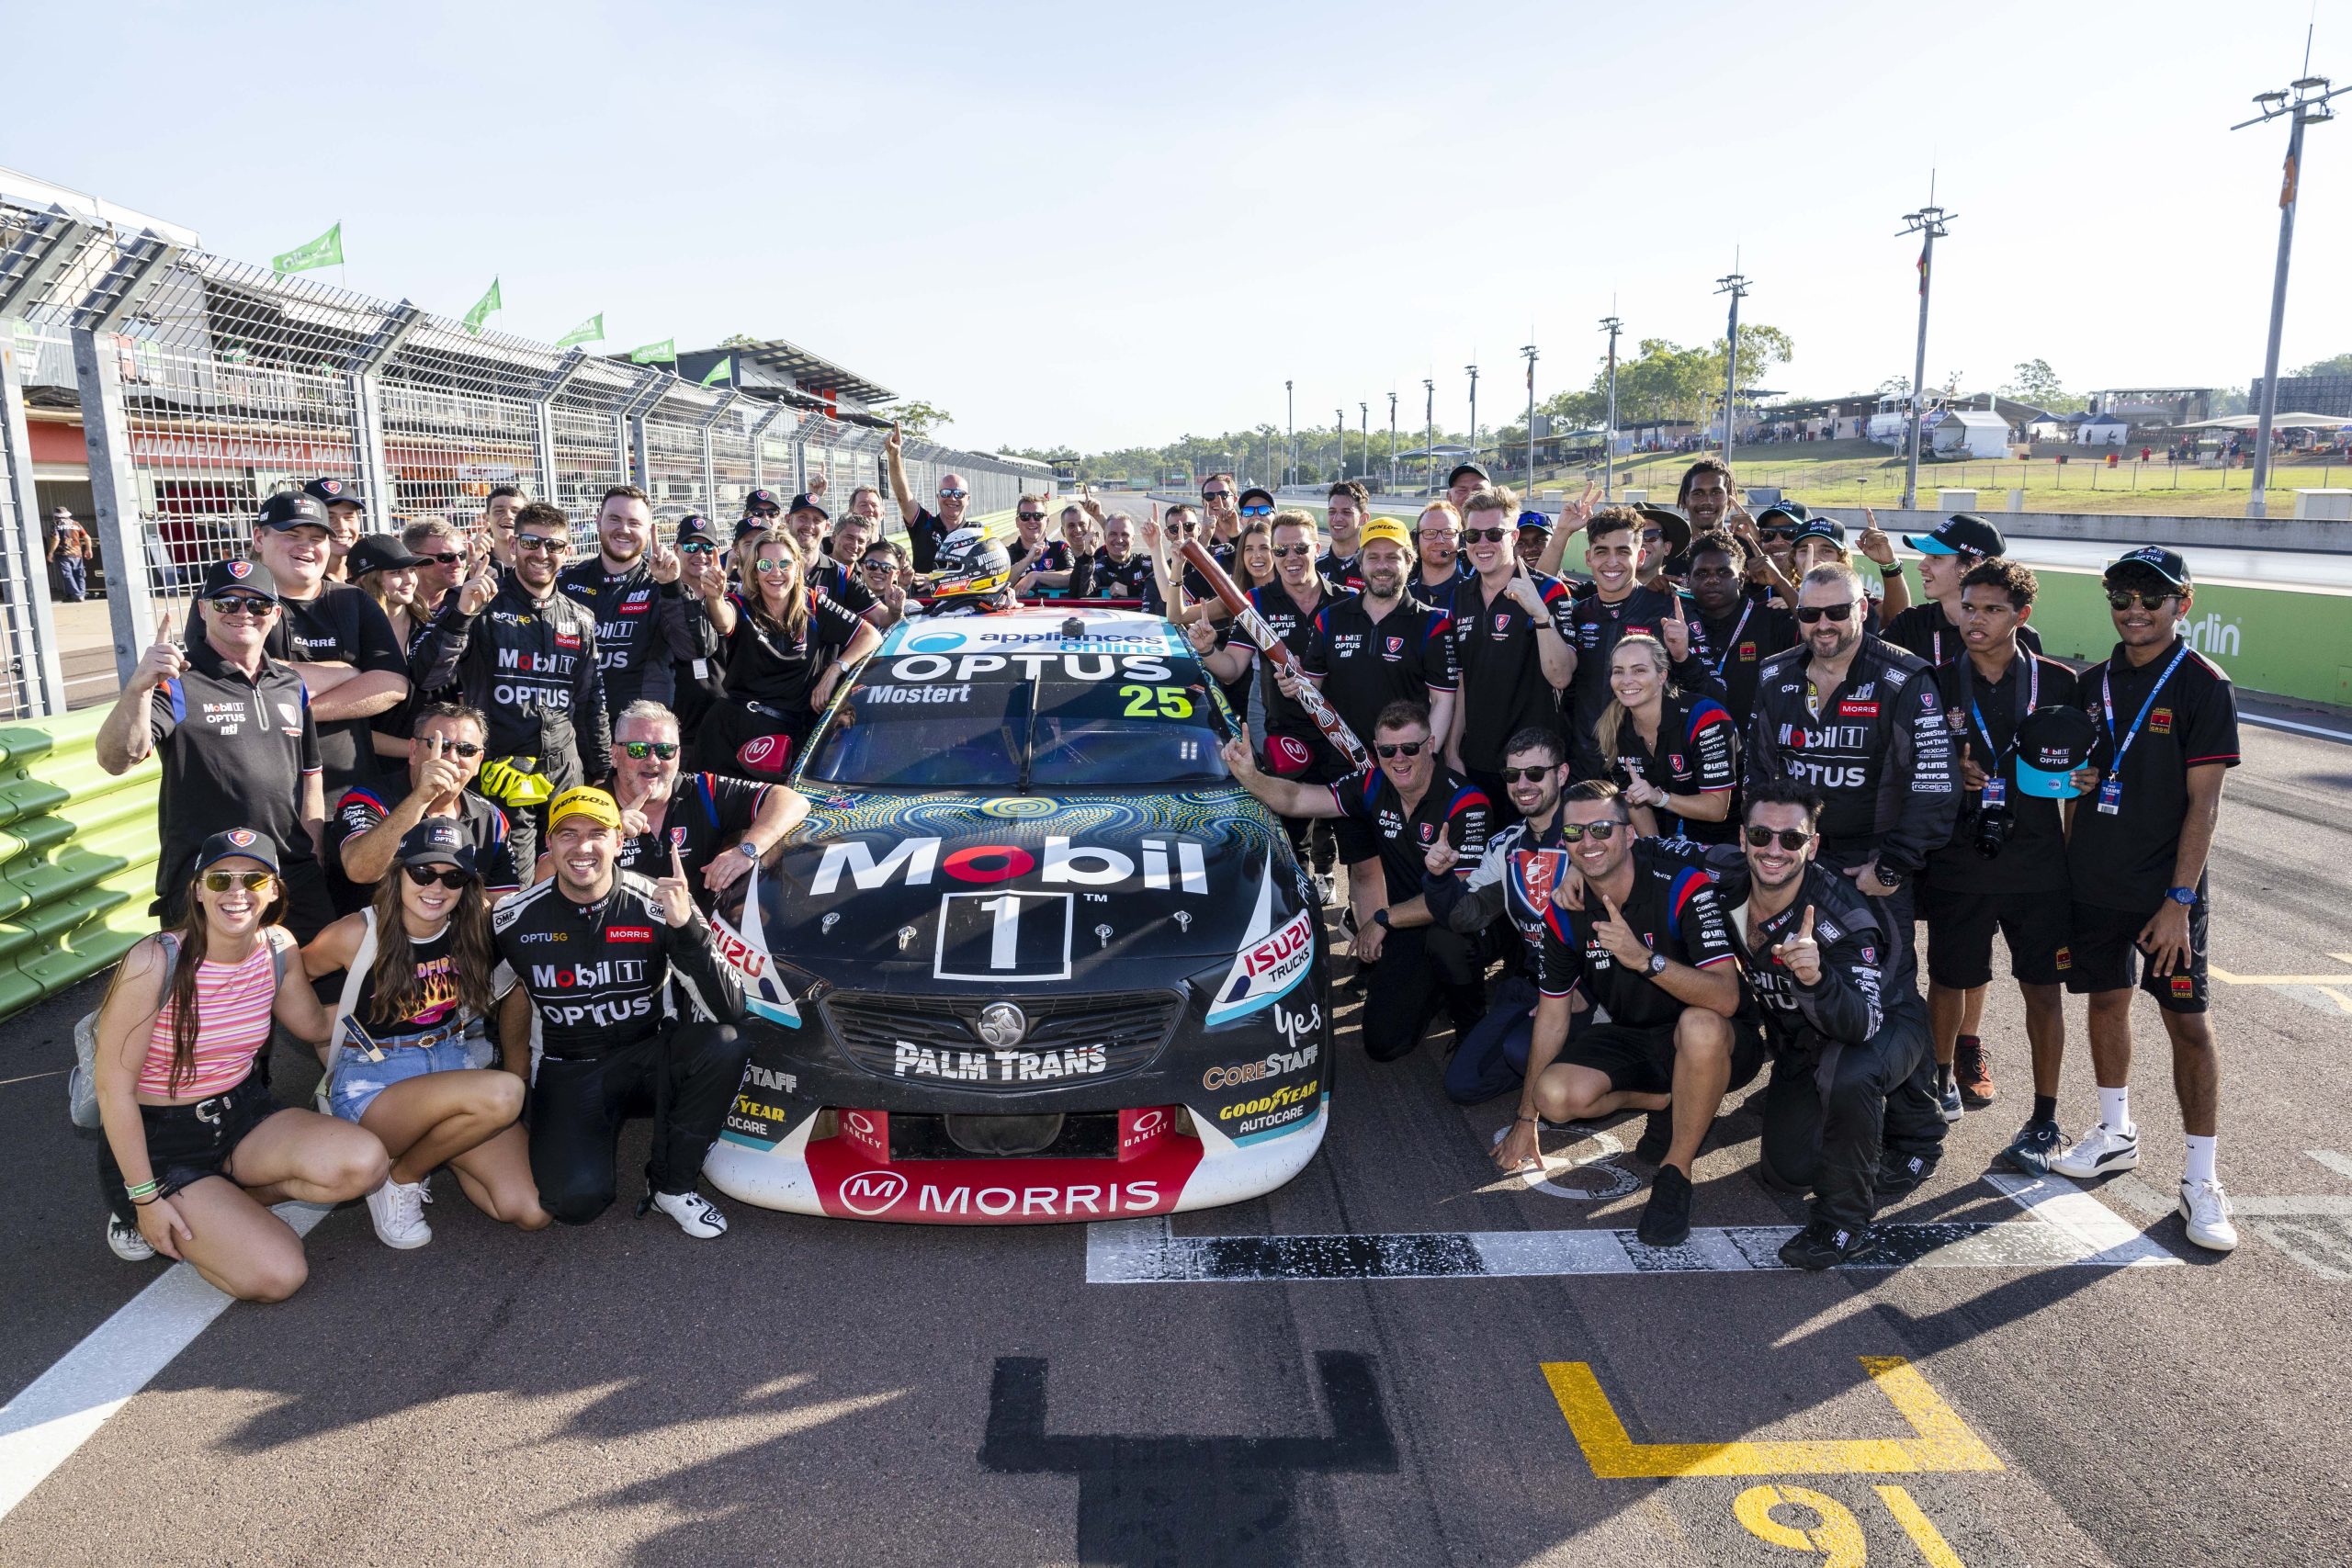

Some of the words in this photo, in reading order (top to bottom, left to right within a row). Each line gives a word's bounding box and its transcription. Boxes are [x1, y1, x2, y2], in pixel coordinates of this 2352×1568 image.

[227, 441, 300, 459] VALLEY
[294, 636, 336, 648] CARRÉ
[979, 631, 1163, 646] appliances
[2176, 613, 2240, 656] erlin
[1060, 641, 1163, 654] online
[1340, 649, 1352, 658] nti
[498, 648, 557, 672] Mobil
[891, 655, 1172, 681] OPTUS
[2164, 660, 2178, 680] EVENT
[1762, 665, 1779, 679] OMP
[1885, 670, 1905, 683] OMP
[494, 684, 570, 707] OPTUS
[867, 683, 971, 705] Mostert
[2153, 678, 2165, 694] ONLY
[203, 703, 232, 713] Mobil
[1120, 684, 1193, 718] 25
[206, 714, 245, 723] OPTUS
[220, 724, 237, 735] nti
[1778, 723, 1838, 749] Mobil
[552, 795, 610, 815] DUNLOP
[1385, 829, 1397, 839] nti
[809, 836, 1208, 896] Mobil
[495, 912, 514, 926] OMP
[579, 903, 602, 915] Mobil
[650, 906, 666, 918] OM
[1768, 915, 1787, 932] Mobil
[1819, 922, 1838, 940] OMP
[610, 931, 650, 939] MORRIS
[1244, 915, 1312, 977] ISUZU
[710, 944, 741, 988] OPTUS
[1269, 946, 1310, 983] TRUCKS
[1596, 959, 1610, 969] nti
[532, 961, 611, 988] Mobil
[543, 996, 651, 1027] OPTUS
[895, 1040, 988, 1080] PALM
[995, 1043, 1106, 1080] TRANS
[1219, 1080, 1317, 1121] GOODYEAR
[1240, 1105, 1304, 1134] AUTOCARE
[843, 1122, 882, 1148] OAKLEY
[1124, 1120, 1168, 1147] OAKLEY
[919, 1180, 1159, 1215] MORRIS
